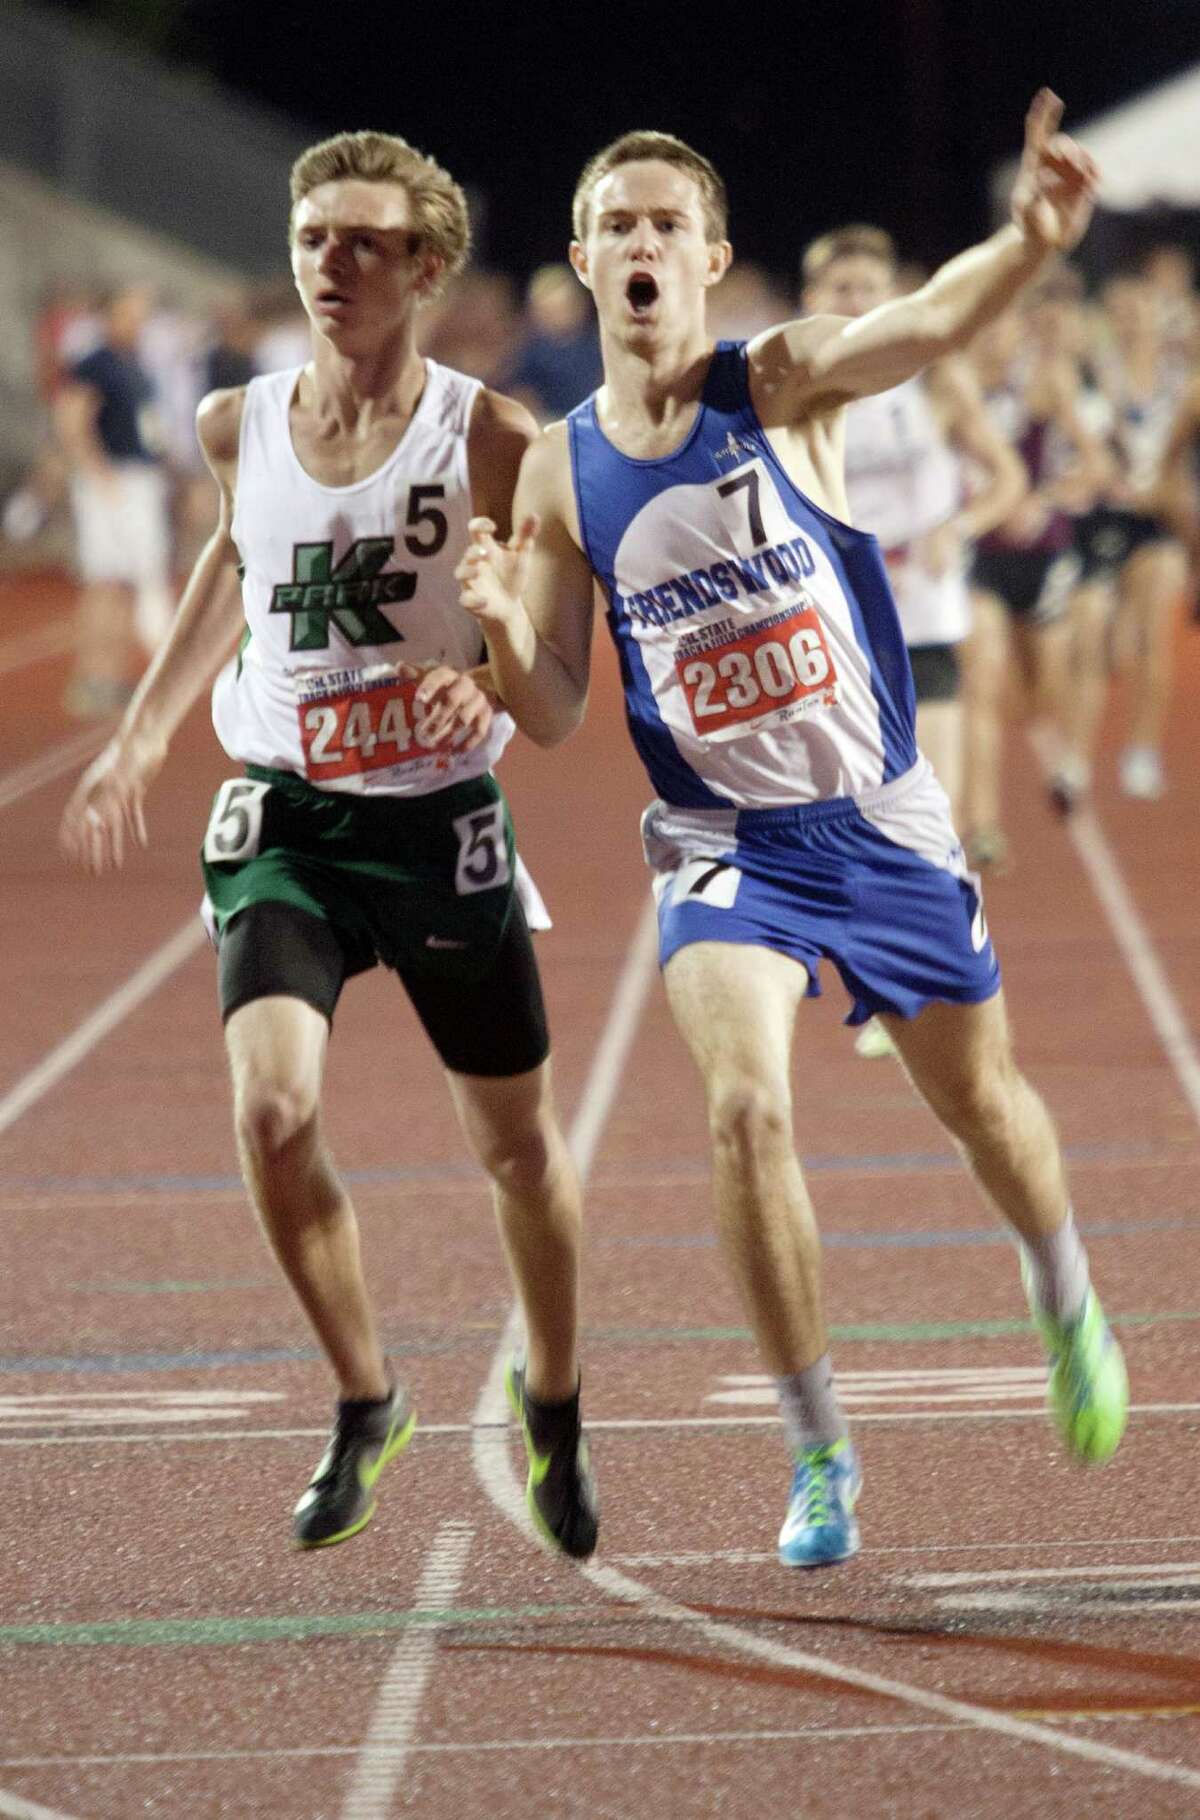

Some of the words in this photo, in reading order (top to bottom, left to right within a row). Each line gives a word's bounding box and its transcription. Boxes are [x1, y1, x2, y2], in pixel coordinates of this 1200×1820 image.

[404, 484, 448, 557] 5
[716, 468, 768, 548] 7
[290, 537, 404, 651] K
[627, 537, 817, 630] FRIENDSWOOD
[698, 617, 736, 642] STATE
[683, 628, 830, 718] 2306
[214, 785, 256, 852] 5
[463, 811, 498, 884] 5
